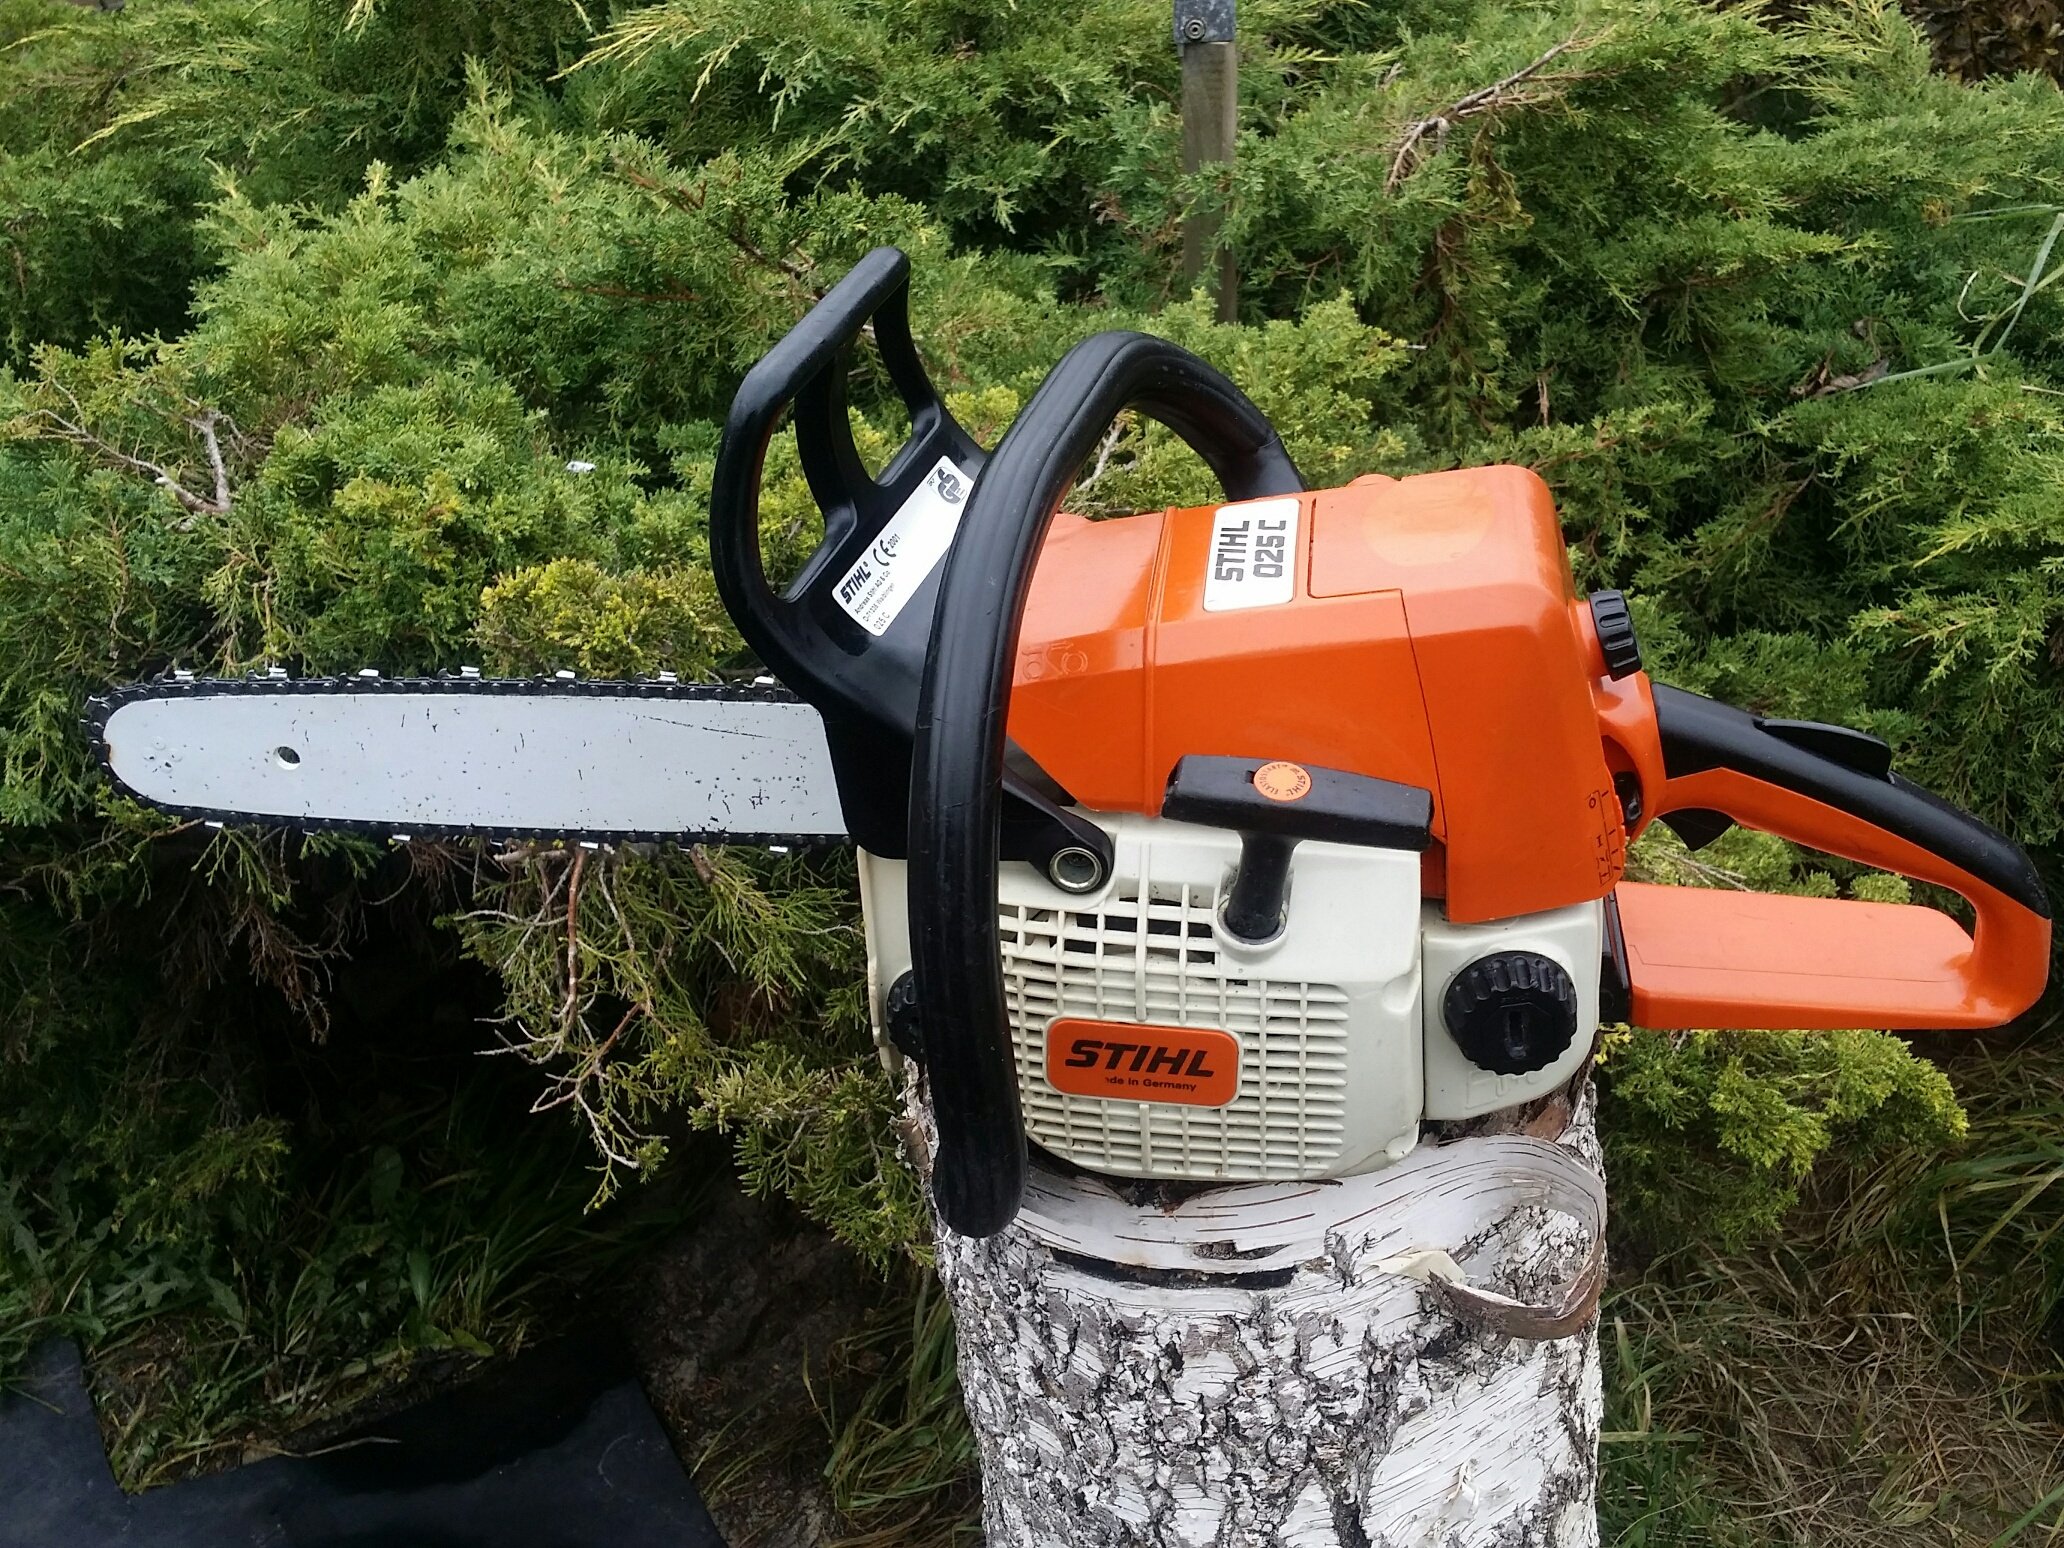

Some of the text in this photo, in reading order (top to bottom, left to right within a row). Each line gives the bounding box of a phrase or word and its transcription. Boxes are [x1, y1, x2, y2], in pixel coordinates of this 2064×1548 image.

[1215, 520, 1250, 582] STIHL
[1253, 519, 1286, 578] 025 C
[840, 565, 871, 604] STIHL
[888, 533, 900, 548] 2001
[874, 617, 886, 630] 025
[1286, 775, 1306, 796] STIHL
[1064, 1039, 1215, 1078] STIHL
[1143, 1079, 1197, 1092] Germany
